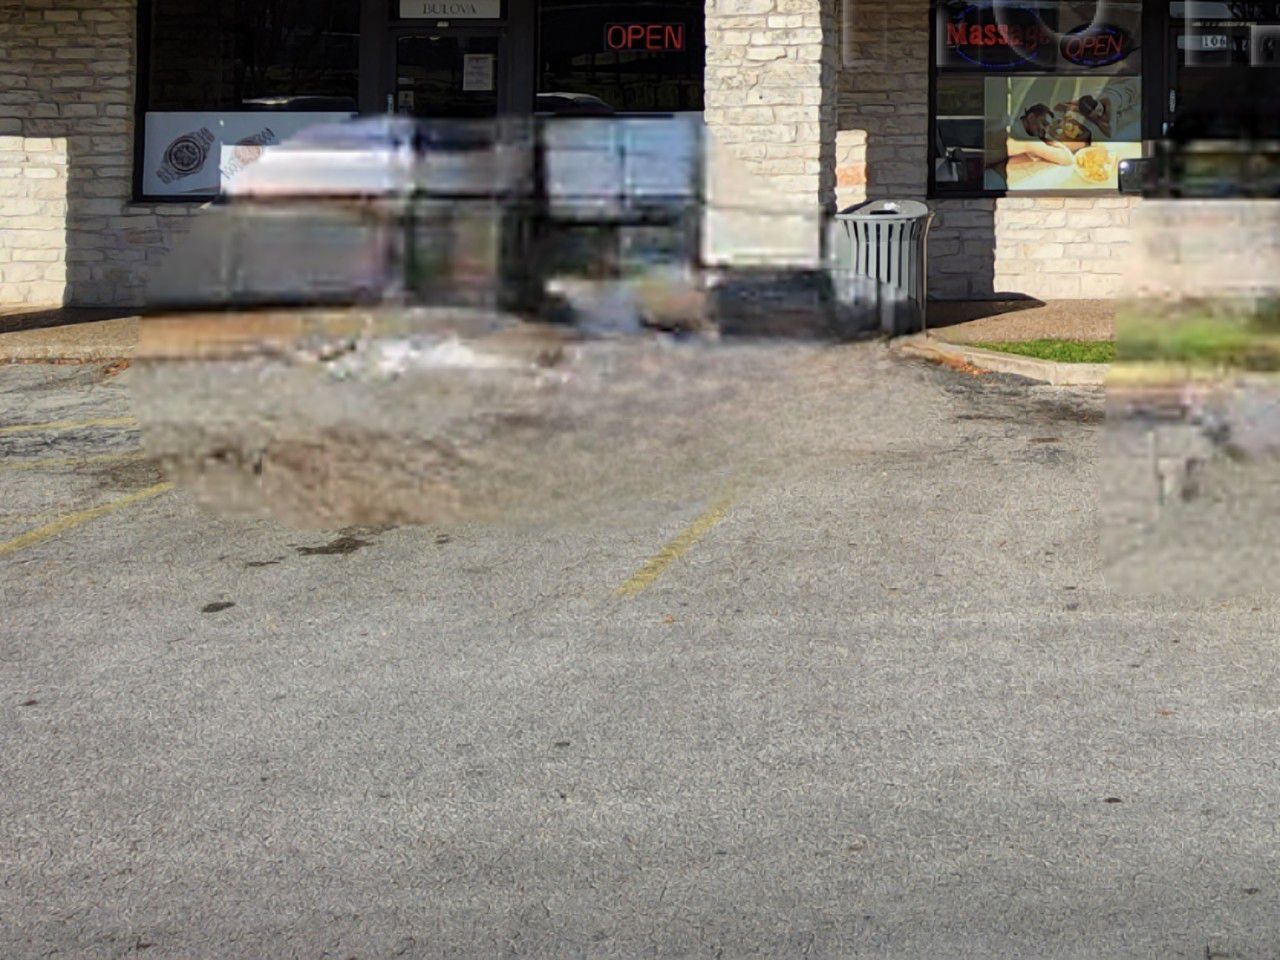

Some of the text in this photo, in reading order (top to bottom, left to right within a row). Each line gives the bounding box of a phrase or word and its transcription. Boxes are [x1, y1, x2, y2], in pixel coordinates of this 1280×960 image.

[422, 3, 478, 15] BULOVA
[607, 25, 682, 50] OPEN
[1065, 32, 1123, 60] OPEN
